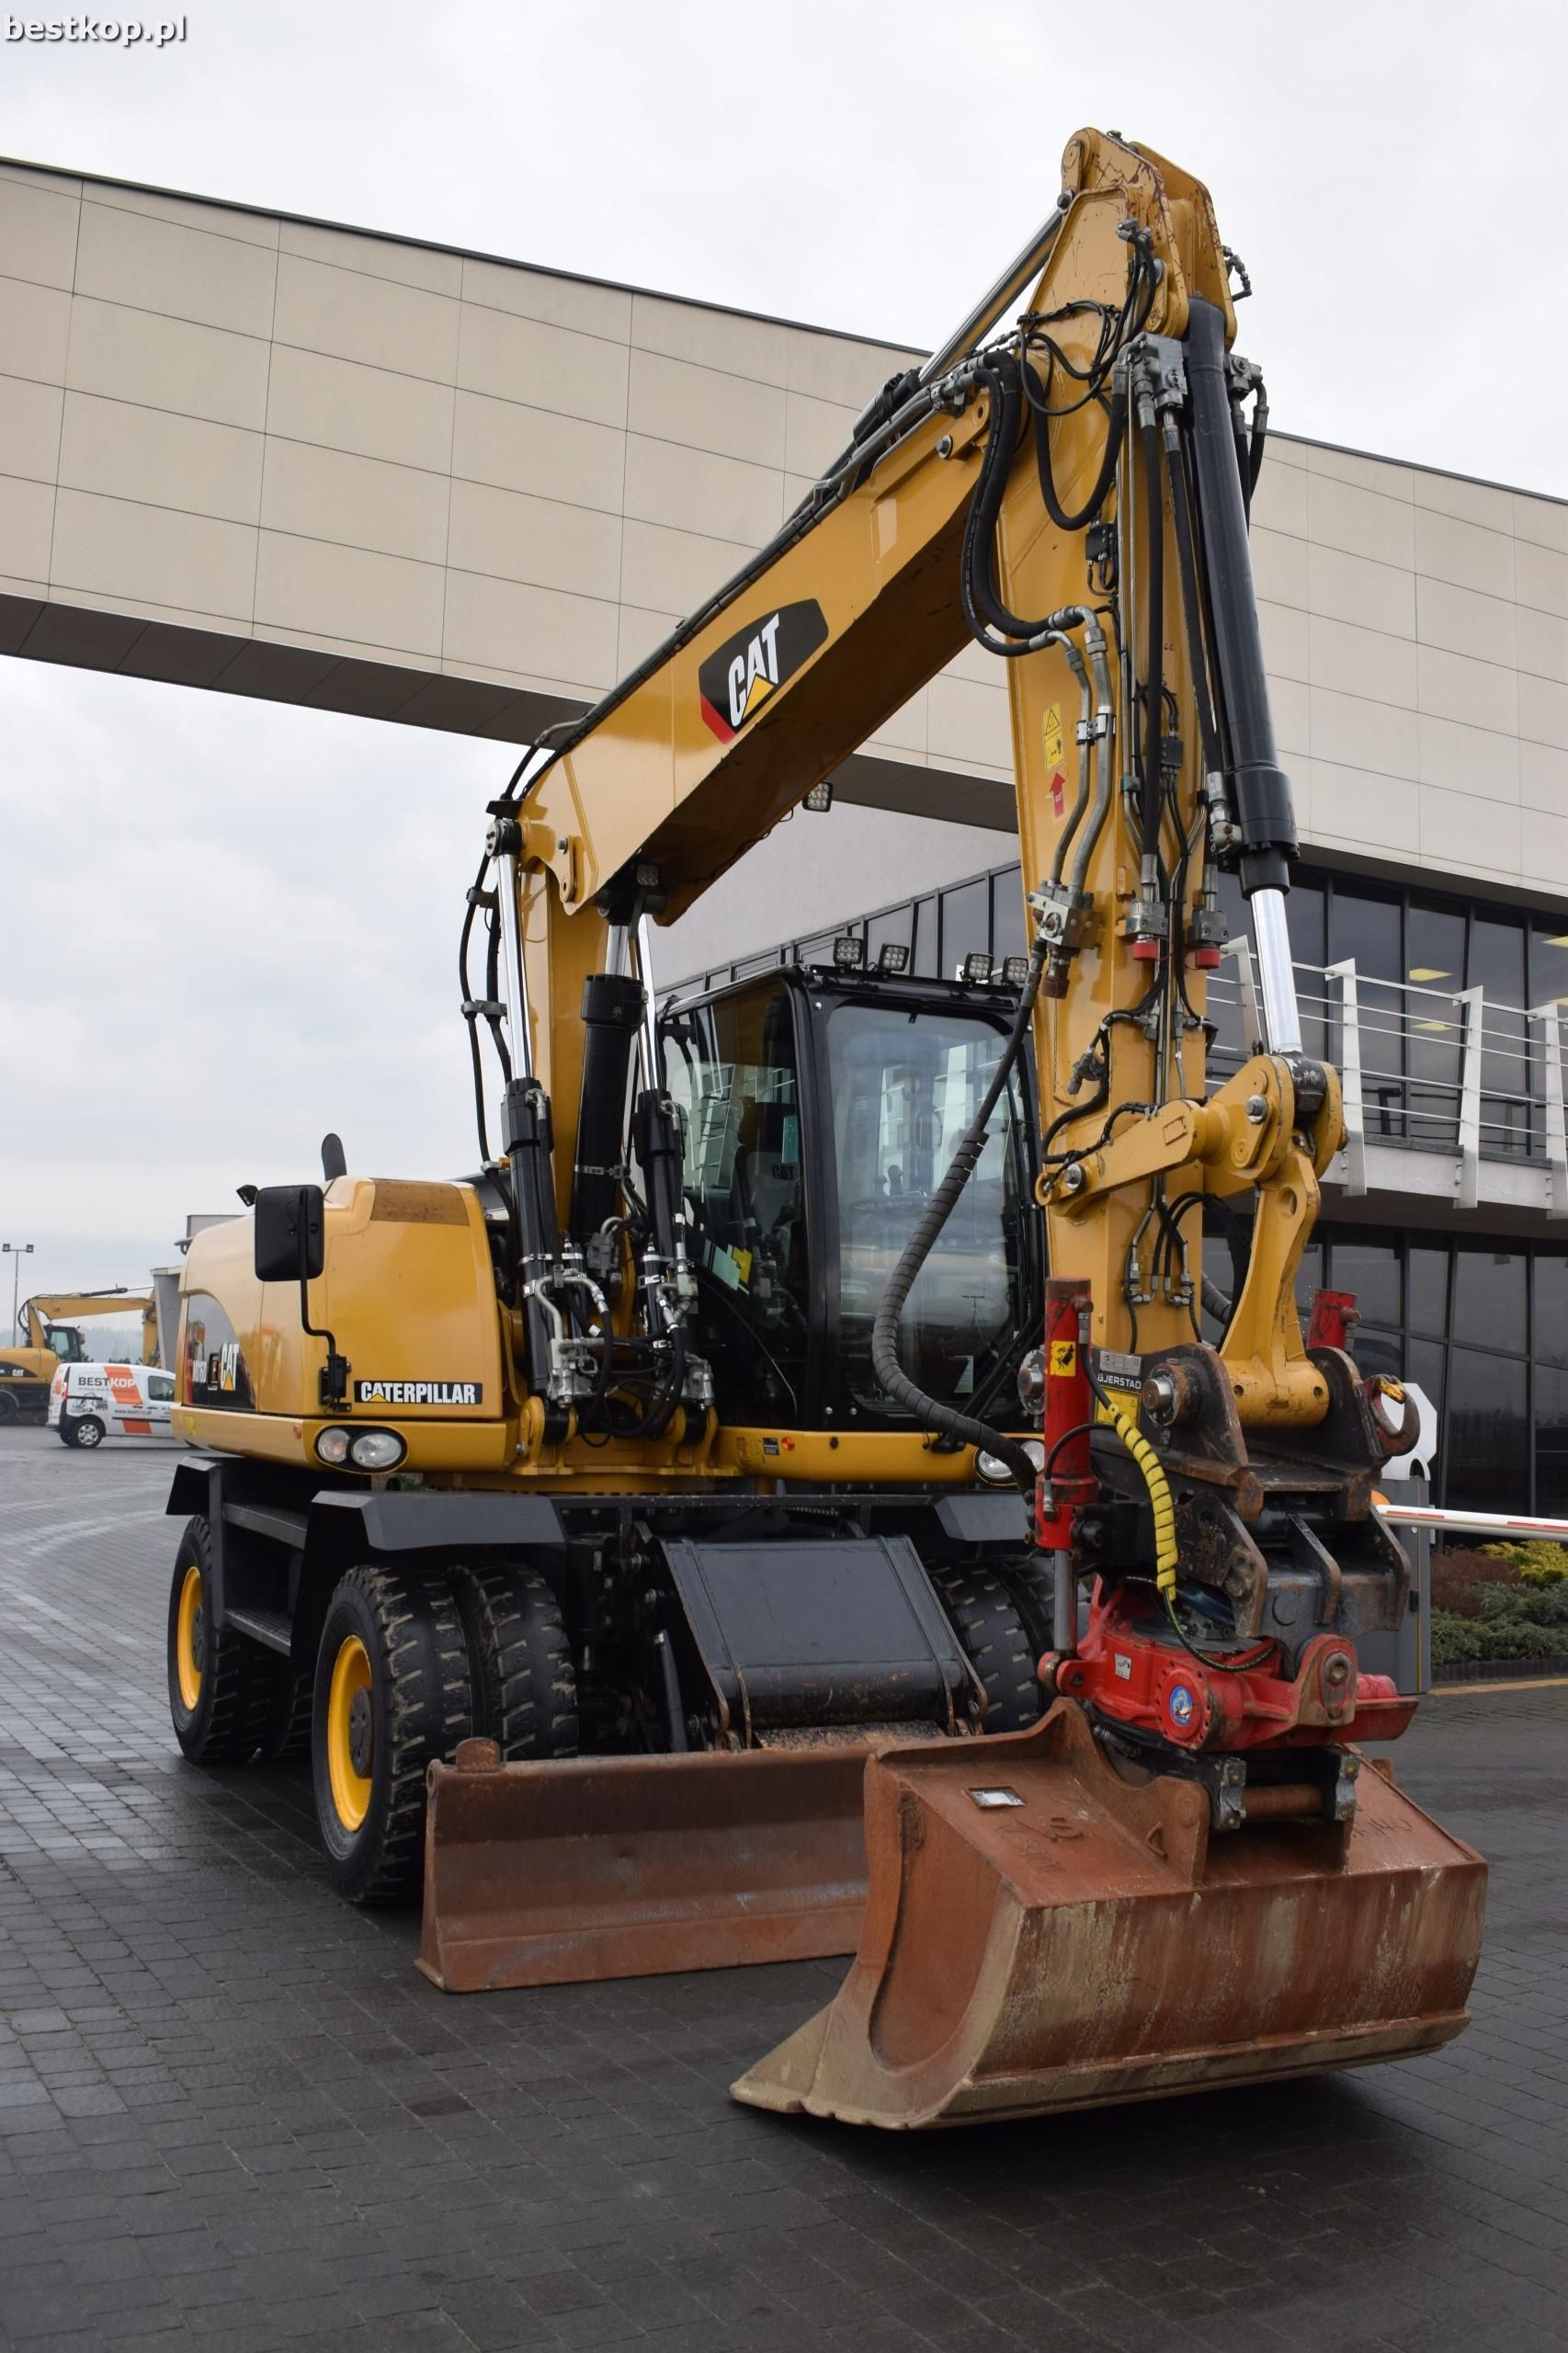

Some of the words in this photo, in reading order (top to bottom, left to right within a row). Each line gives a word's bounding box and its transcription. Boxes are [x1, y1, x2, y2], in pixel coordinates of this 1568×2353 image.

[728, 612, 779, 727] CAT
[772, 1165, 795, 1181] CAT
[221, 1343, 239, 1391] CAT
[78, 1377, 136, 1388] BESTKOP
[1097, 1373, 1142, 1390] GJERSTAD
[360, 1381, 476, 1404] CATERPILLAR
